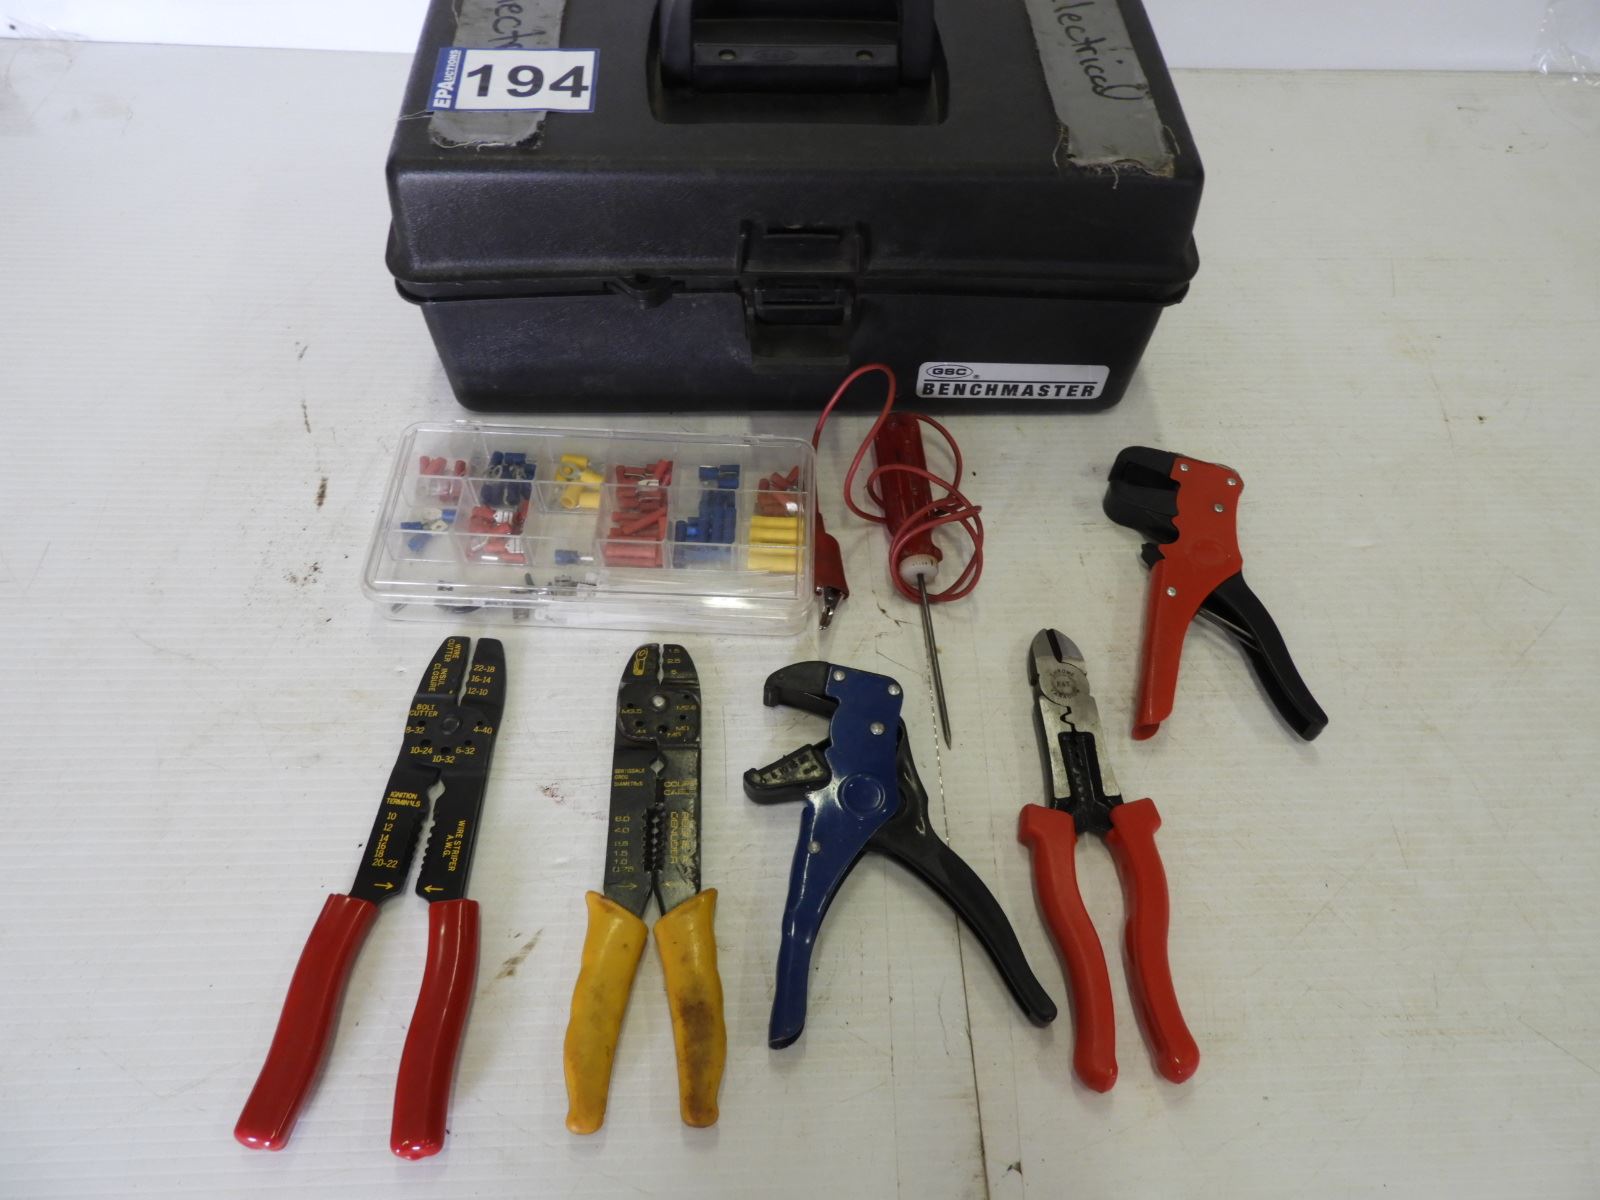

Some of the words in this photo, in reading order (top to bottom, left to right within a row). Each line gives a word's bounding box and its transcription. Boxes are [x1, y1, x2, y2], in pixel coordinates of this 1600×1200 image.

[1052, 0, 1150, 100] lectrical
[466, 64, 589, 98] 194
[932, 367, 968, 376] GSC
[922, 382, 1096, 397] BENCHMASTER
[444, 638, 456, 663] CUTTER
[452, 643, 462, 659] WIRE
[473, 664, 496, 673] 22-18
[470, 675, 492, 684] 16-14
[467, 687, 489, 696] 12-10
[416, 703, 435, 711] BOLT
[387, 811, 397, 820] 10
[383, 823, 394, 832] 12
[454, 819, 466, 839] WIRE
[379, 834, 390, 842] 14
[448, 840, 462, 872] STRIPPER
[371, 858, 399, 869] 20-22
